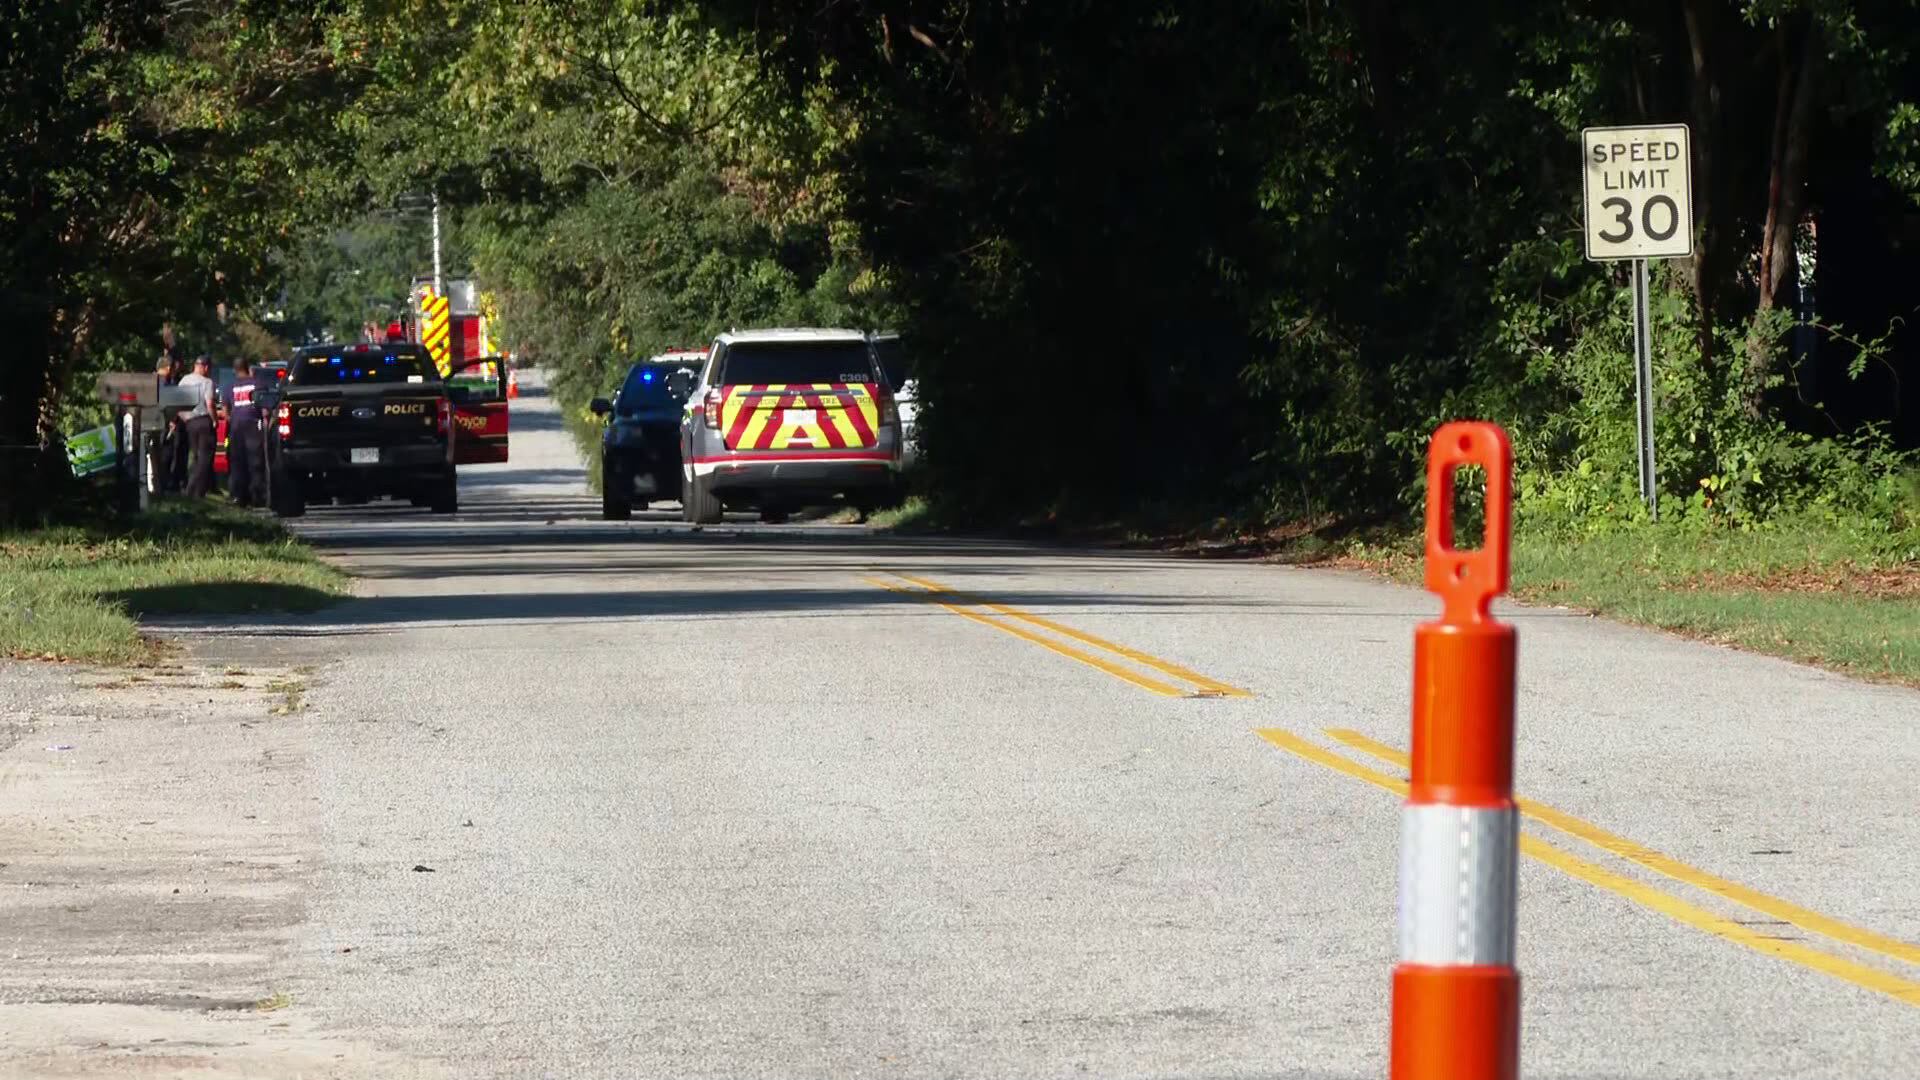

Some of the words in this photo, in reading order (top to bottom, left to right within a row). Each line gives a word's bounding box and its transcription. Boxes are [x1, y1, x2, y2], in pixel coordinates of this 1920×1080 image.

[1592, 141, 1680, 163] SPEED
[1604, 168, 1669, 190] LIMIT
[1598, 194, 1679, 244] 30
[298, 406, 340, 417] CAYCE
[384, 404, 425, 415] POLICE
